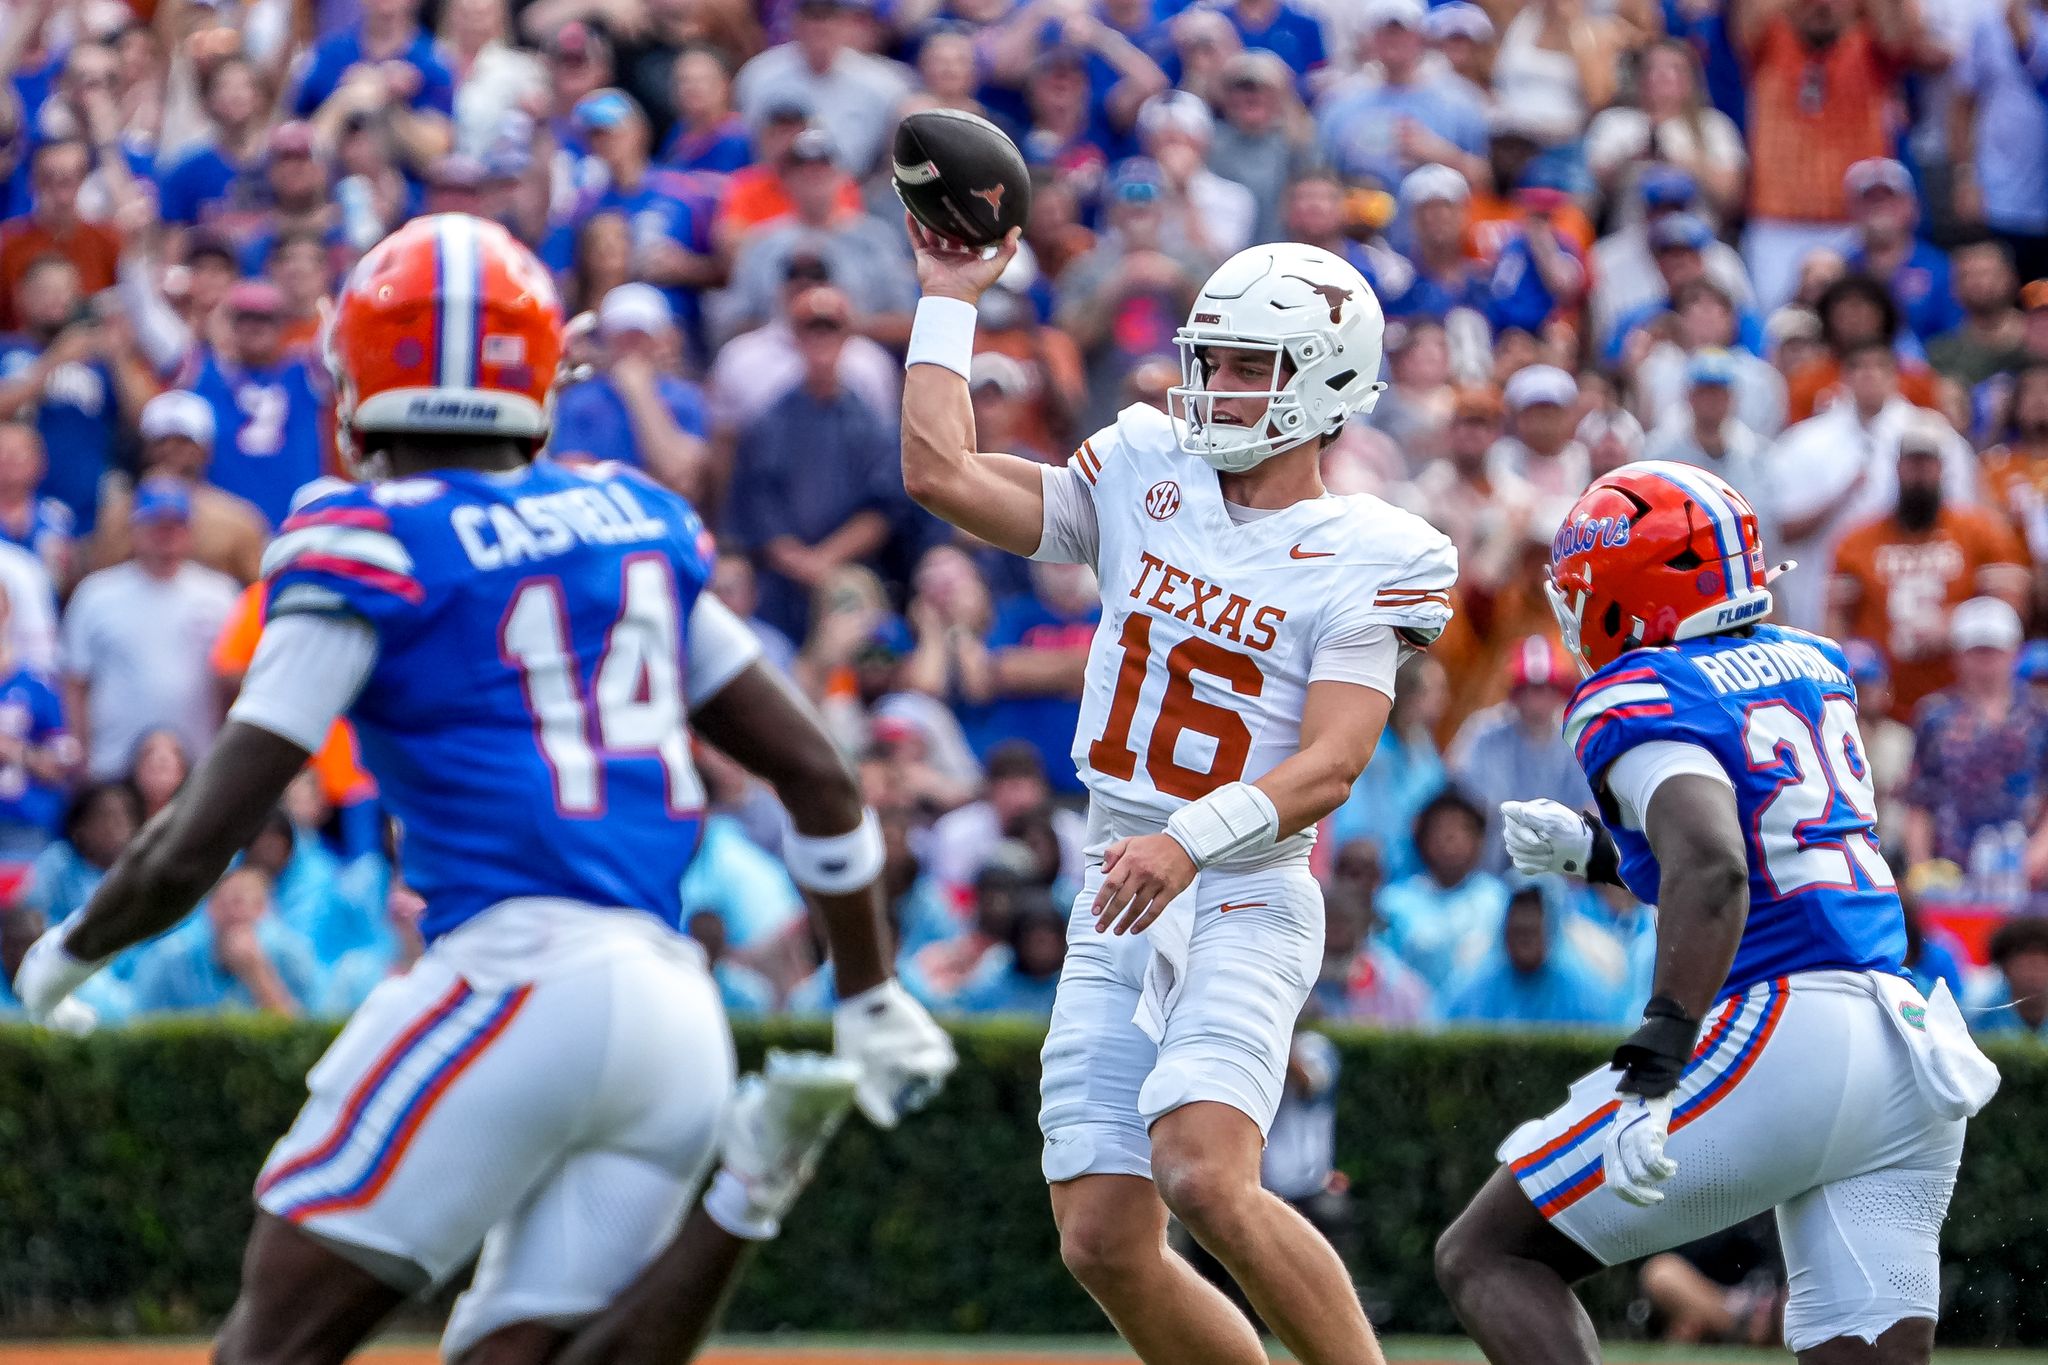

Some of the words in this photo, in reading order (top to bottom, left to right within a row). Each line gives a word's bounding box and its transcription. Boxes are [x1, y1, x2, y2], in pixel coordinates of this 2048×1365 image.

[1146, 481, 1180, 520] SEC
[1129, 550, 1287, 652] TEXAS
[1691, 640, 1849, 694] ROBINSON
[496, 551, 708, 820] 14
[1088, 610, 1264, 802] 16
[1740, 693, 1898, 901] 29
